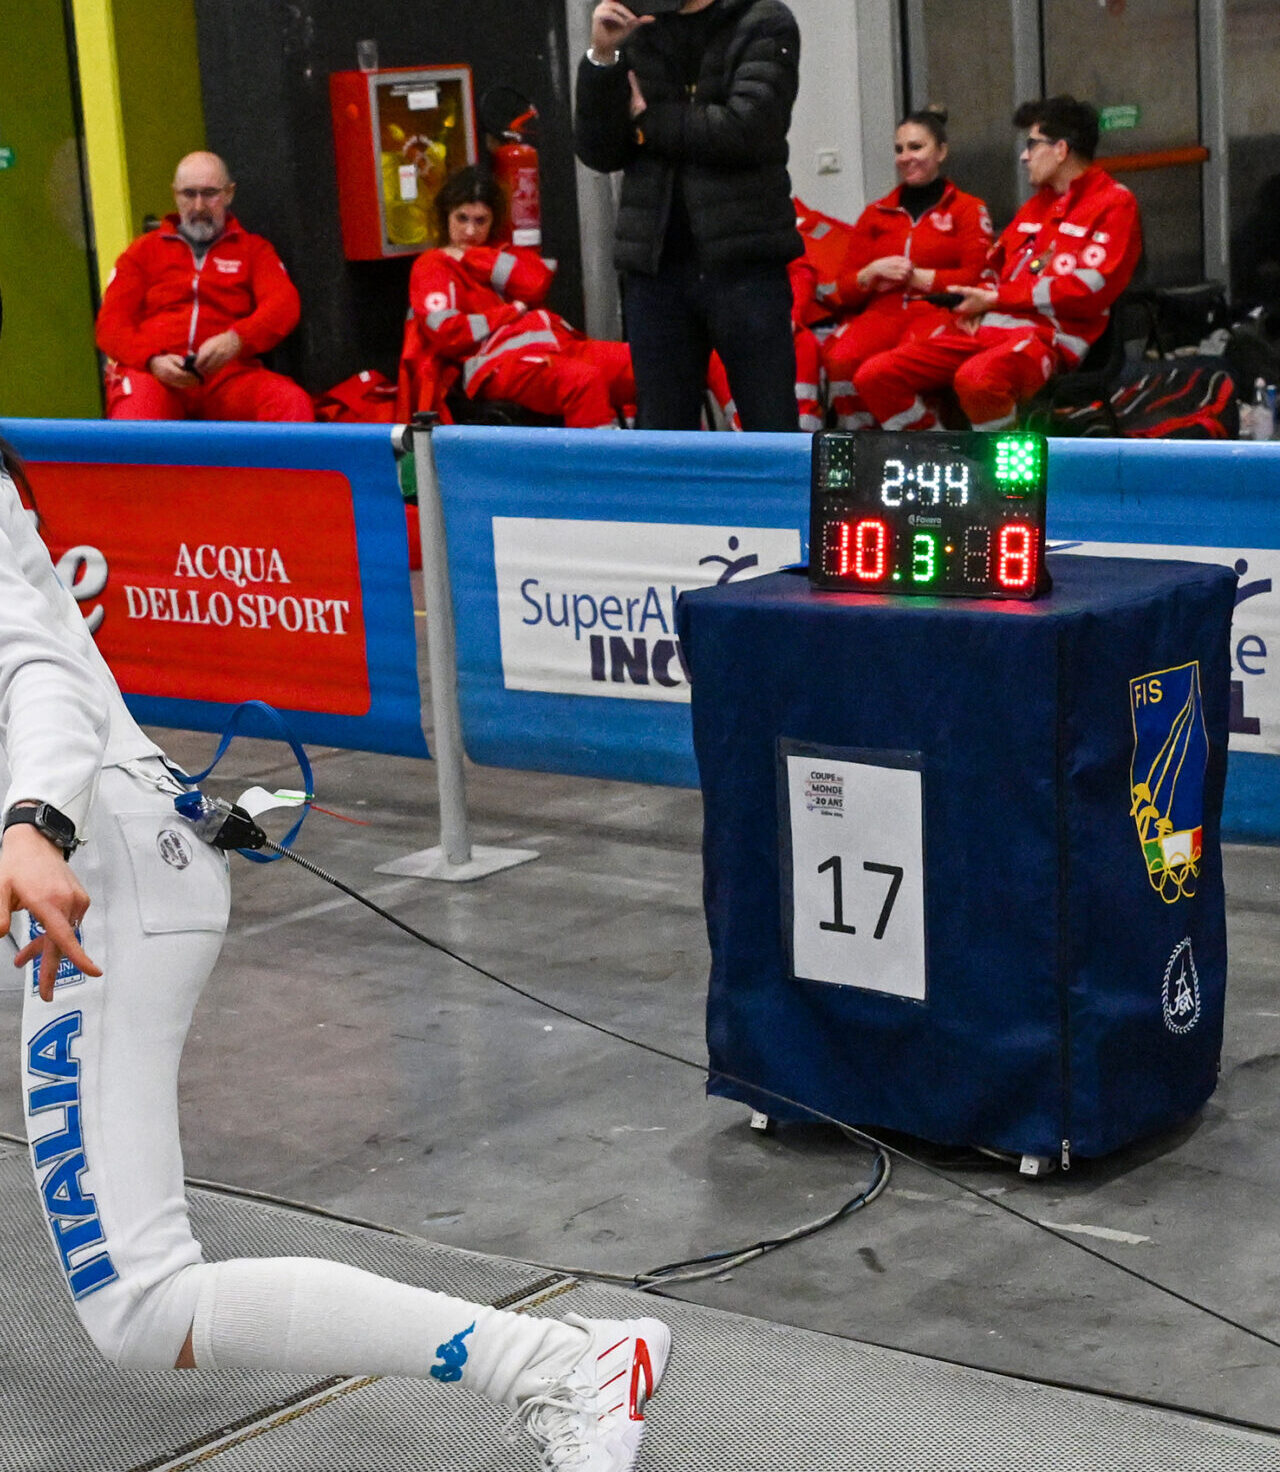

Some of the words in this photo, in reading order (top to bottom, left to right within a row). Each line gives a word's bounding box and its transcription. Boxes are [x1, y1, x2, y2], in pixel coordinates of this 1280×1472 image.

[881, 459, 969, 506] 2:44
[174, 543, 291, 588] ACQUA
[841, 521, 884, 579] 10
[913, 534, 935, 582] 3
[999, 525, 1030, 586] 8
[123, 585, 234, 627] DELLO
[236, 593, 351, 636] SPORT
[1134, 679, 1163, 708] FIS
[810, 771, 836, 781] COUPE
[811, 784, 844, 795] MONDE
[828, 798, 843, 808] ANS
[817, 855, 904, 940] 17
[27, 1010, 119, 1300] ITALIA
